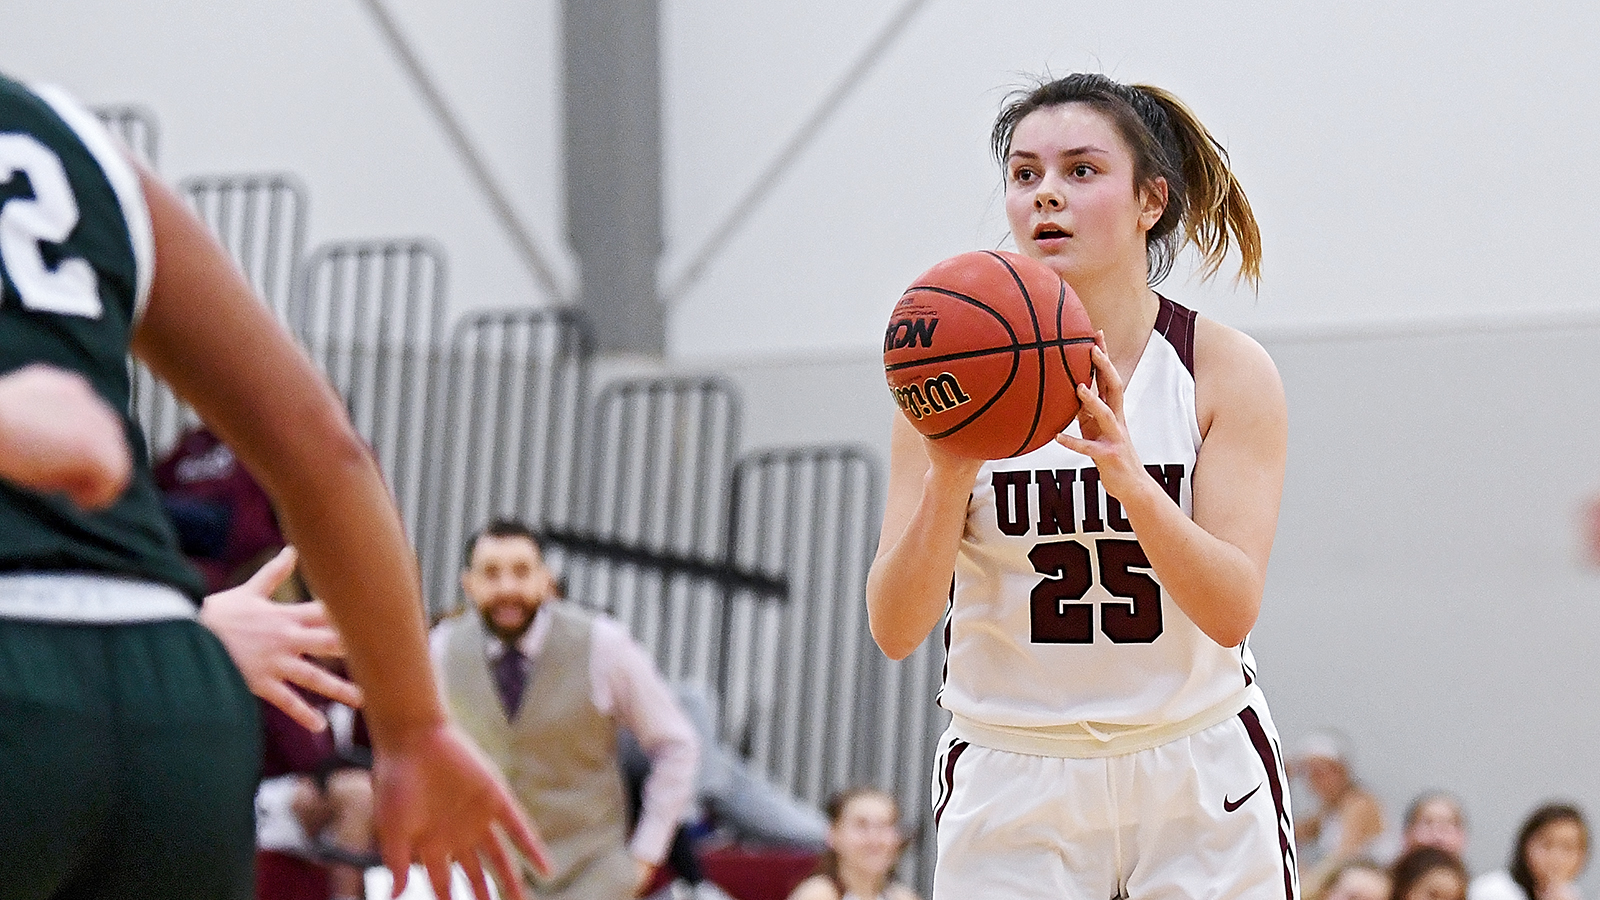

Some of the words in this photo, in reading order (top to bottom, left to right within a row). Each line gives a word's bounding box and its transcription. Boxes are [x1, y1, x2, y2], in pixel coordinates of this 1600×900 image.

[884, 318, 939, 353] NCA
[991, 463, 1185, 537] UNI
[1027, 538, 1164, 645] 25
